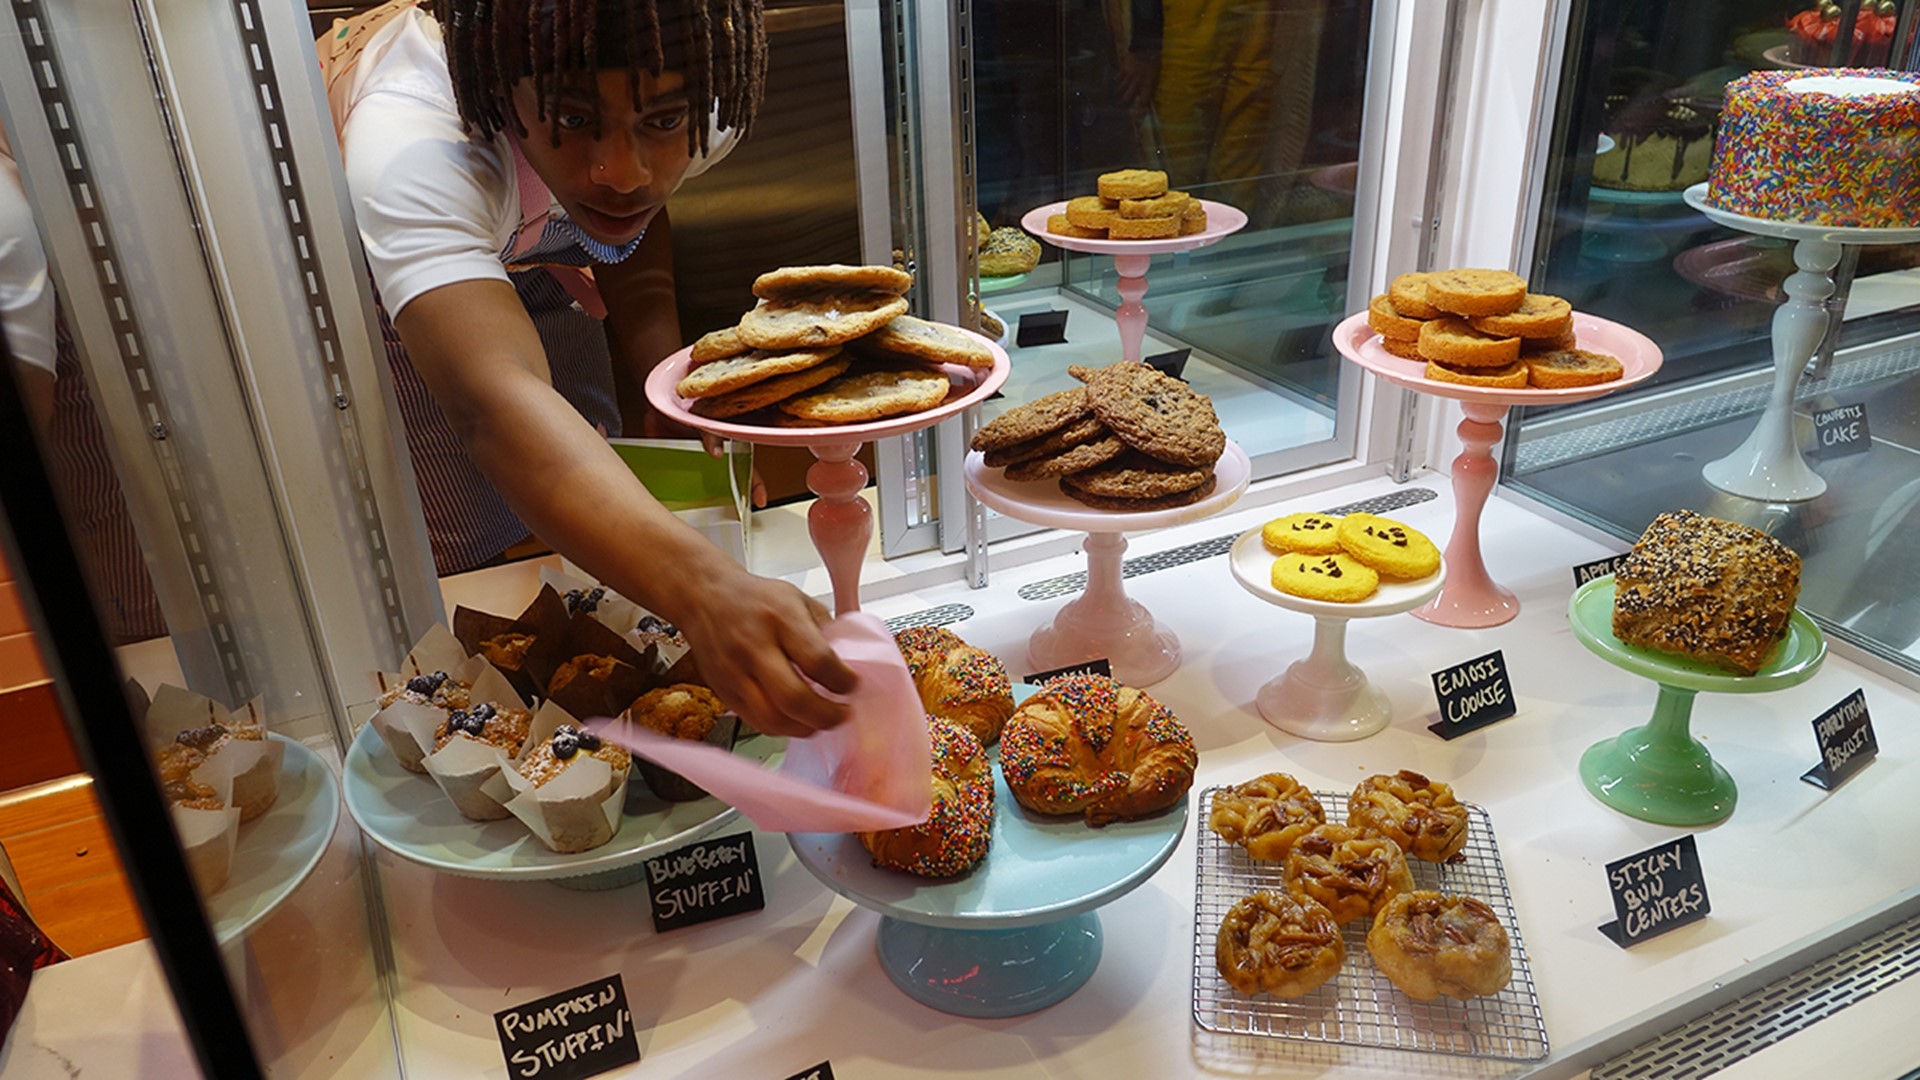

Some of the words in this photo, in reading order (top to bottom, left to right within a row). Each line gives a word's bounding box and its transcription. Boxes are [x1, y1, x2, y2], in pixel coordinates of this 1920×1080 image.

[1815, 405, 1863, 427] CONFETTI
[1823, 421, 1860, 446] CAKE
[1437, 658, 1499, 696] EMOJI
[1825, 724, 1869, 772] BISCUIT
[1610, 844, 1681, 890] STICKY
[655, 868, 753, 919] STUFFIN'
[1623, 875, 1664, 910] BUN
[1626, 883, 1703, 937] CENTERS
[502, 984, 616, 1041] PUMPKIN
